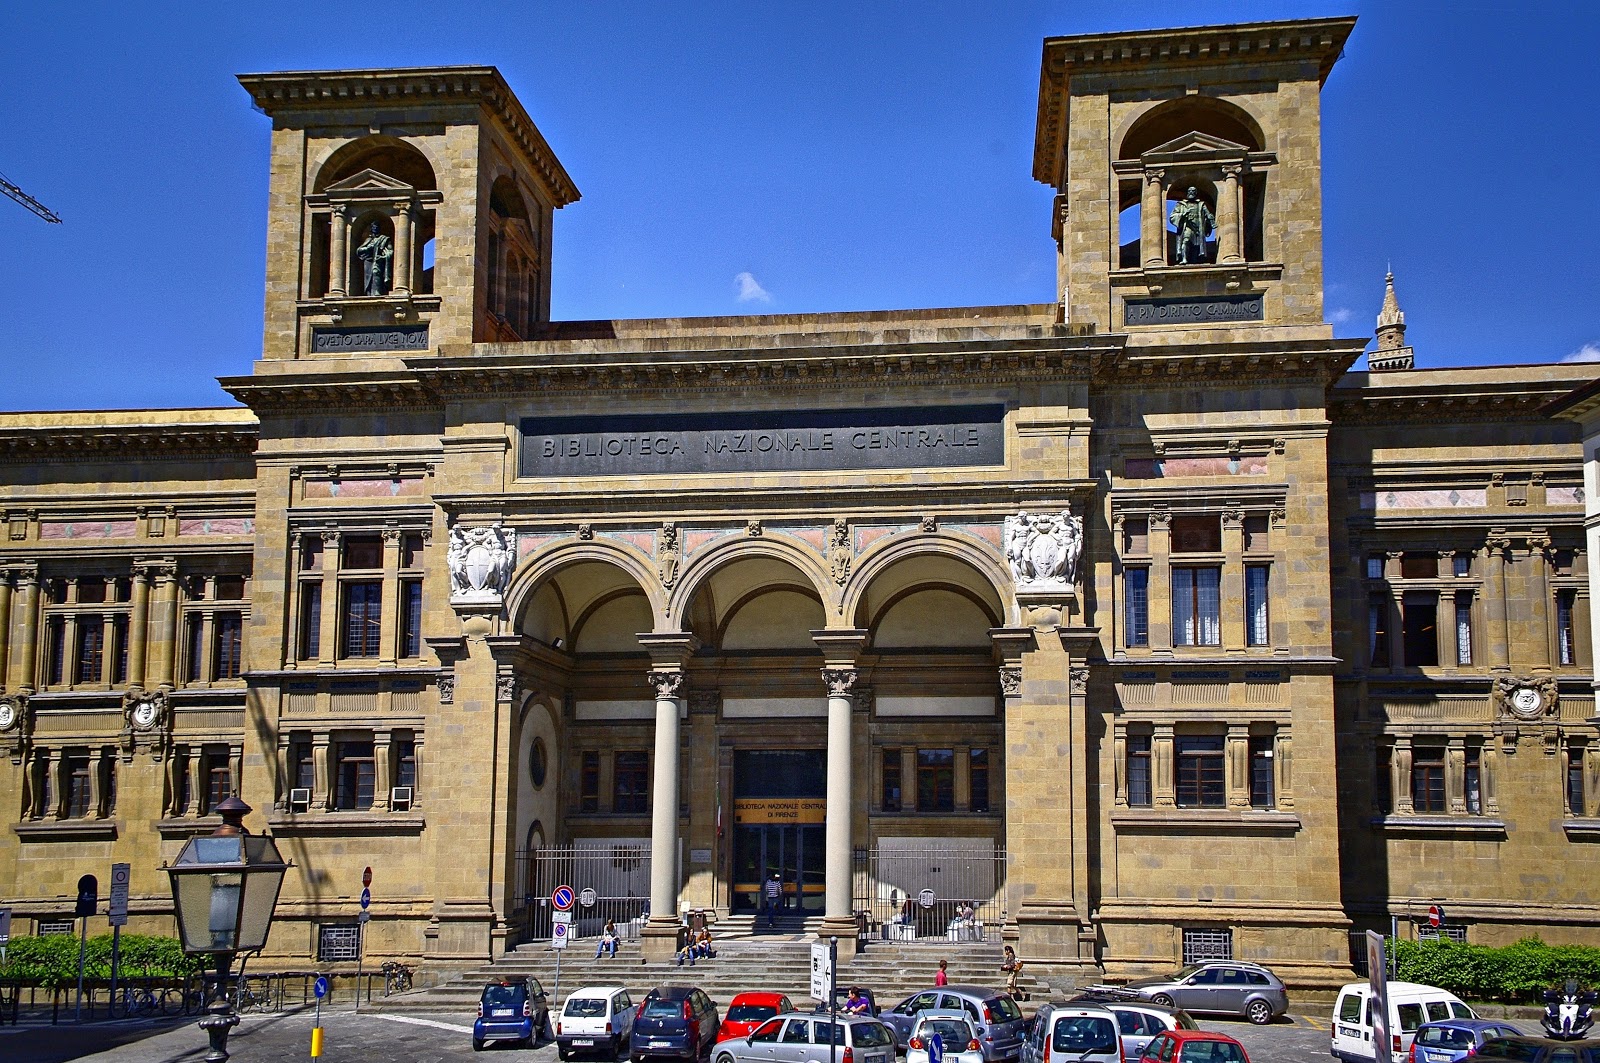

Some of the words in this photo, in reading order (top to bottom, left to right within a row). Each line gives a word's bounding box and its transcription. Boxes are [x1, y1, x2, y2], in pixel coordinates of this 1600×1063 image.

[1128, 308, 1136, 320] A
[1159, 304, 1202, 318] DIRITTO
[1206, 302, 1259, 315] CAMMINO
[542, 437, 685, 458] BIBLIOTECA
[704, 431, 834, 454] NAZIONALE
[851, 427, 979, 449] CENTRALE
